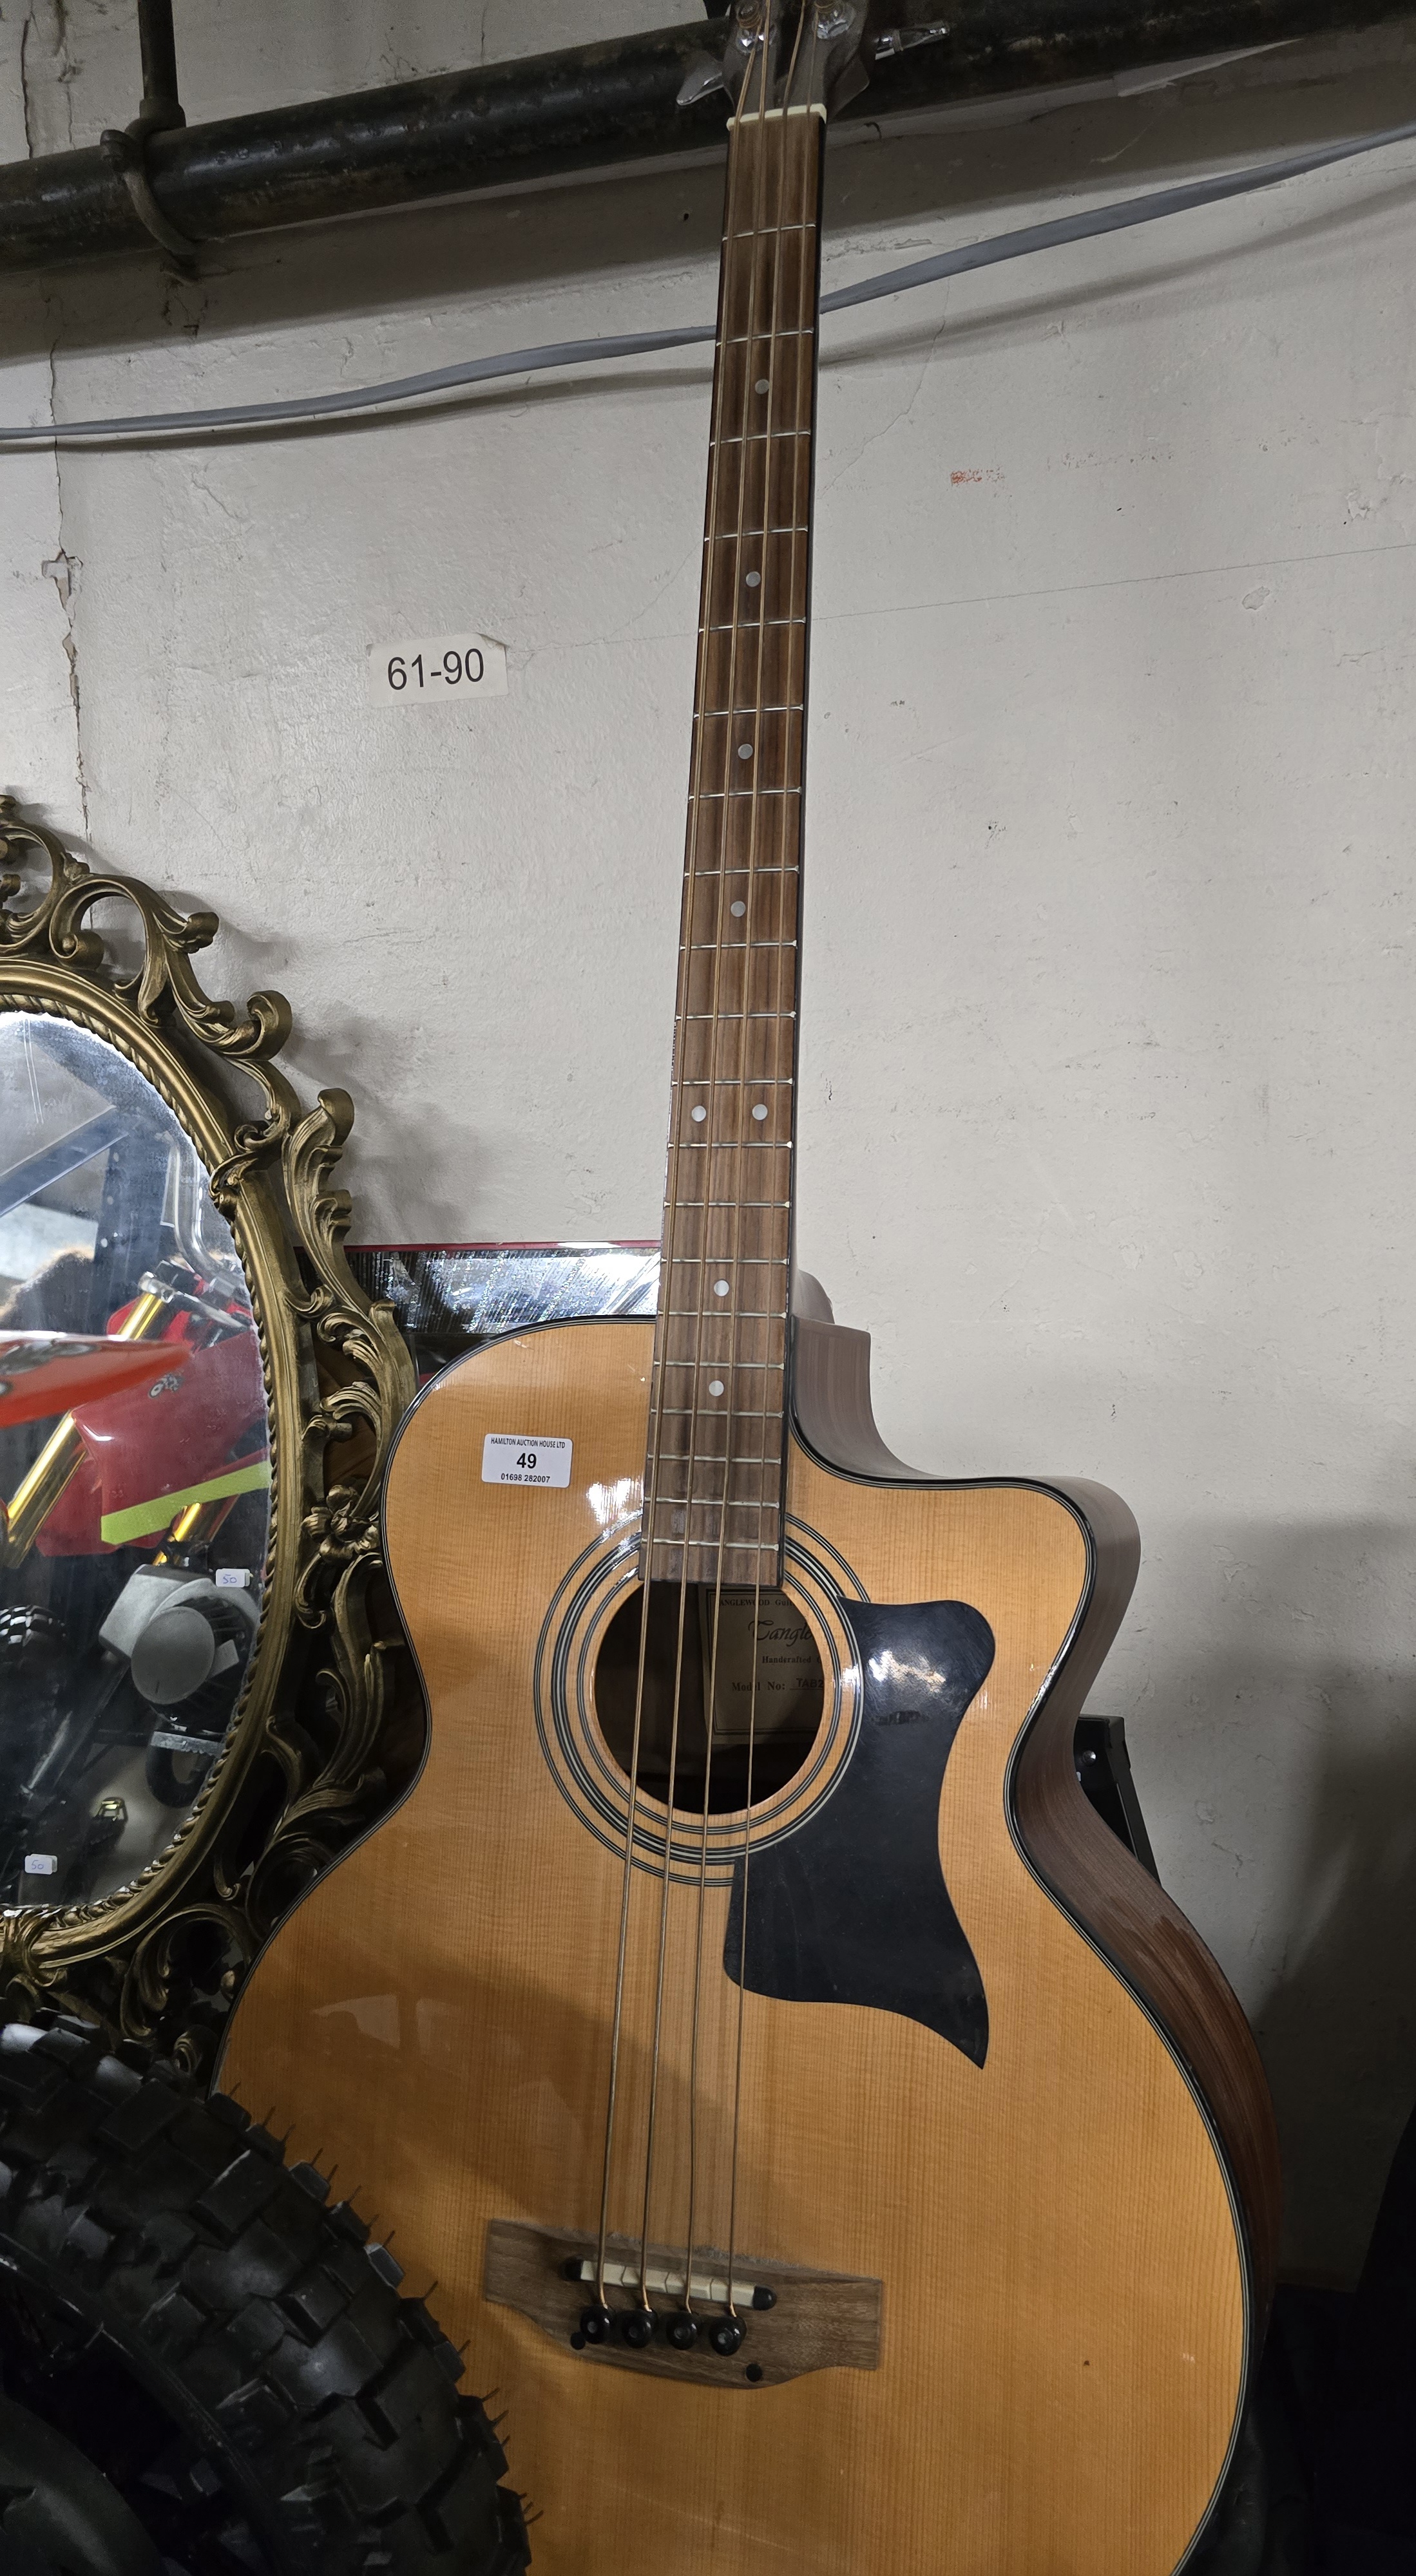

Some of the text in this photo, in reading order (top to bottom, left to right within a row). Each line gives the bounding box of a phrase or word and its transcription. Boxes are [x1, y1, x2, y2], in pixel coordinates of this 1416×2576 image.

[388, 649, 484, 690] 61-90
[491, 1437, 515, 1445] HAMILTON
[517, 1439, 539, 1447] AUCTION
[517, 1453, 537, 1469] 49
[501, 1473, 522, 1481] 01698
[767, 1681, 785, 1690] No:
